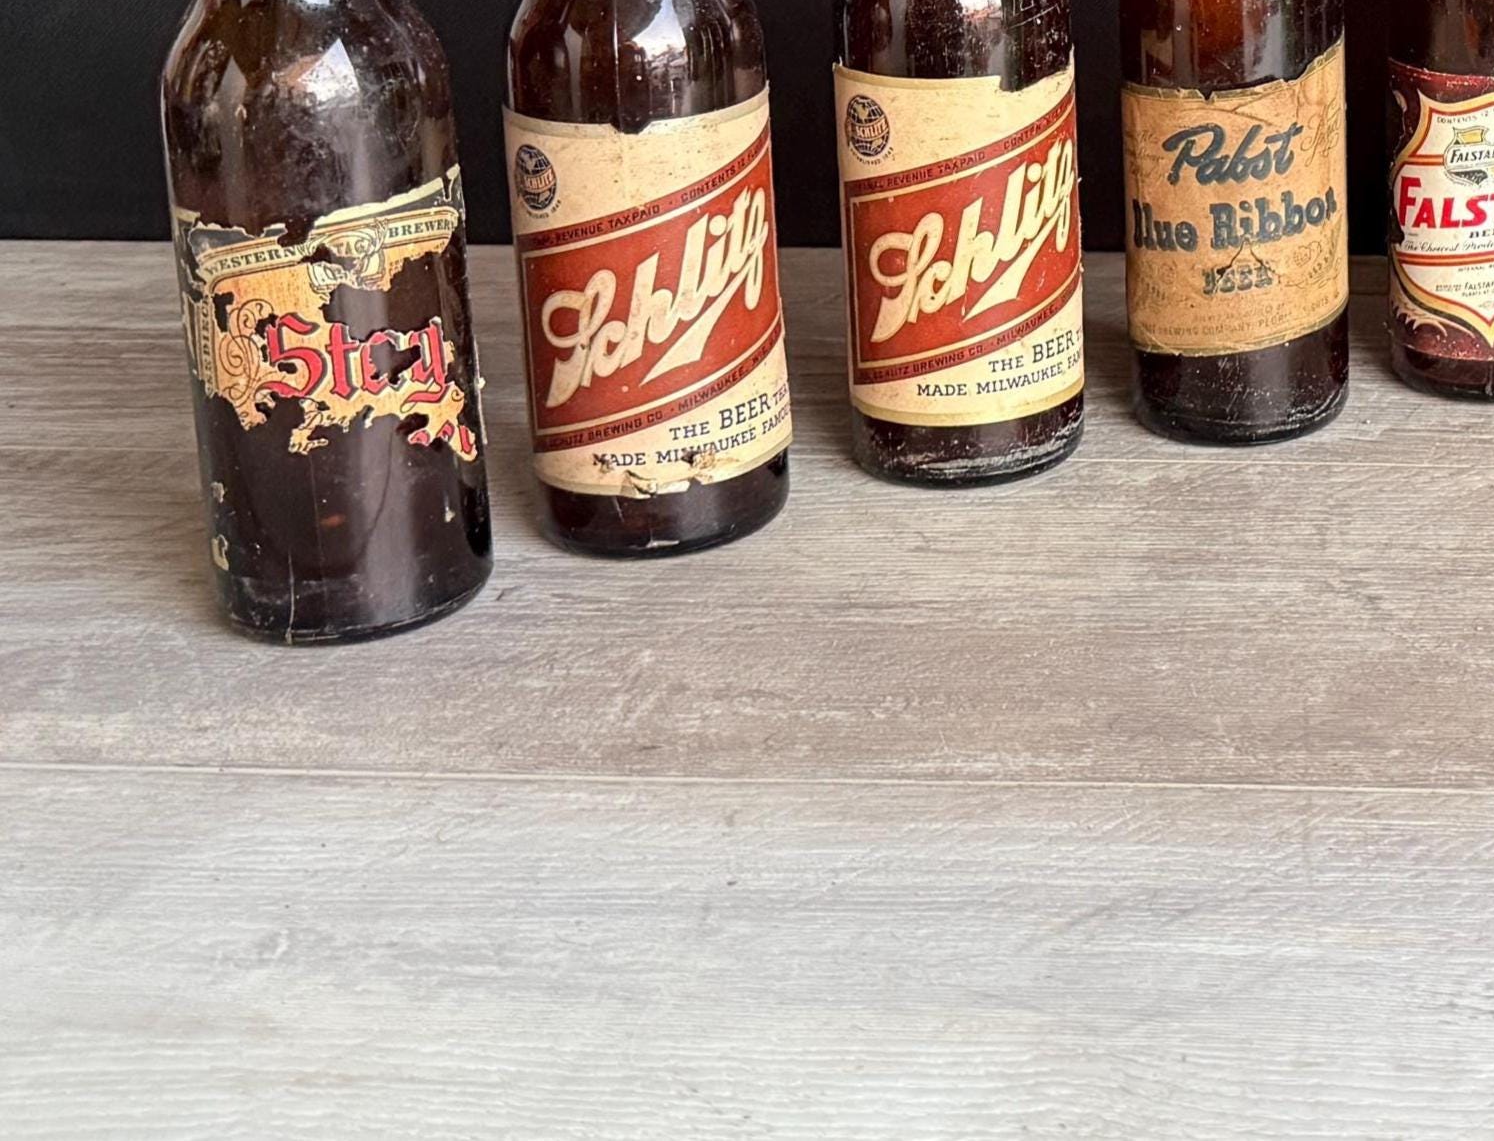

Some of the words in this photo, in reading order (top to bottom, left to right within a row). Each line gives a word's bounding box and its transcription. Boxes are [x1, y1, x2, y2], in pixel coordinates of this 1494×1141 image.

[1436, 114, 1478, 125] CONTENTS
[886, 168, 934, 188] REVENUE
[937, 152, 985, 173] TAXPAID
[1162, 122, 1304, 185] Pabst
[608, 204, 660, 228] TAXPAID
[680, 165, 736, 203] CONTENTS
[869, 136, 1075, 343] Schlitz
[204, 244, 298, 276] WESTERN
[541, 186, 769, 409] Schlitz
[913, 351, 965, 373] BREWING
[988, 355, 1025, 373] THE
[1031, 329, 1075, 364] BEER
[916, 384, 967, 397] MADE
[975, 362, 1063, 395] MILWAUKEE
[587, 418, 642, 441] BREWING
[669, 421, 711, 441] THE
[718, 393, 772, 430] BEER
[592, 452, 646, 468] MADE
